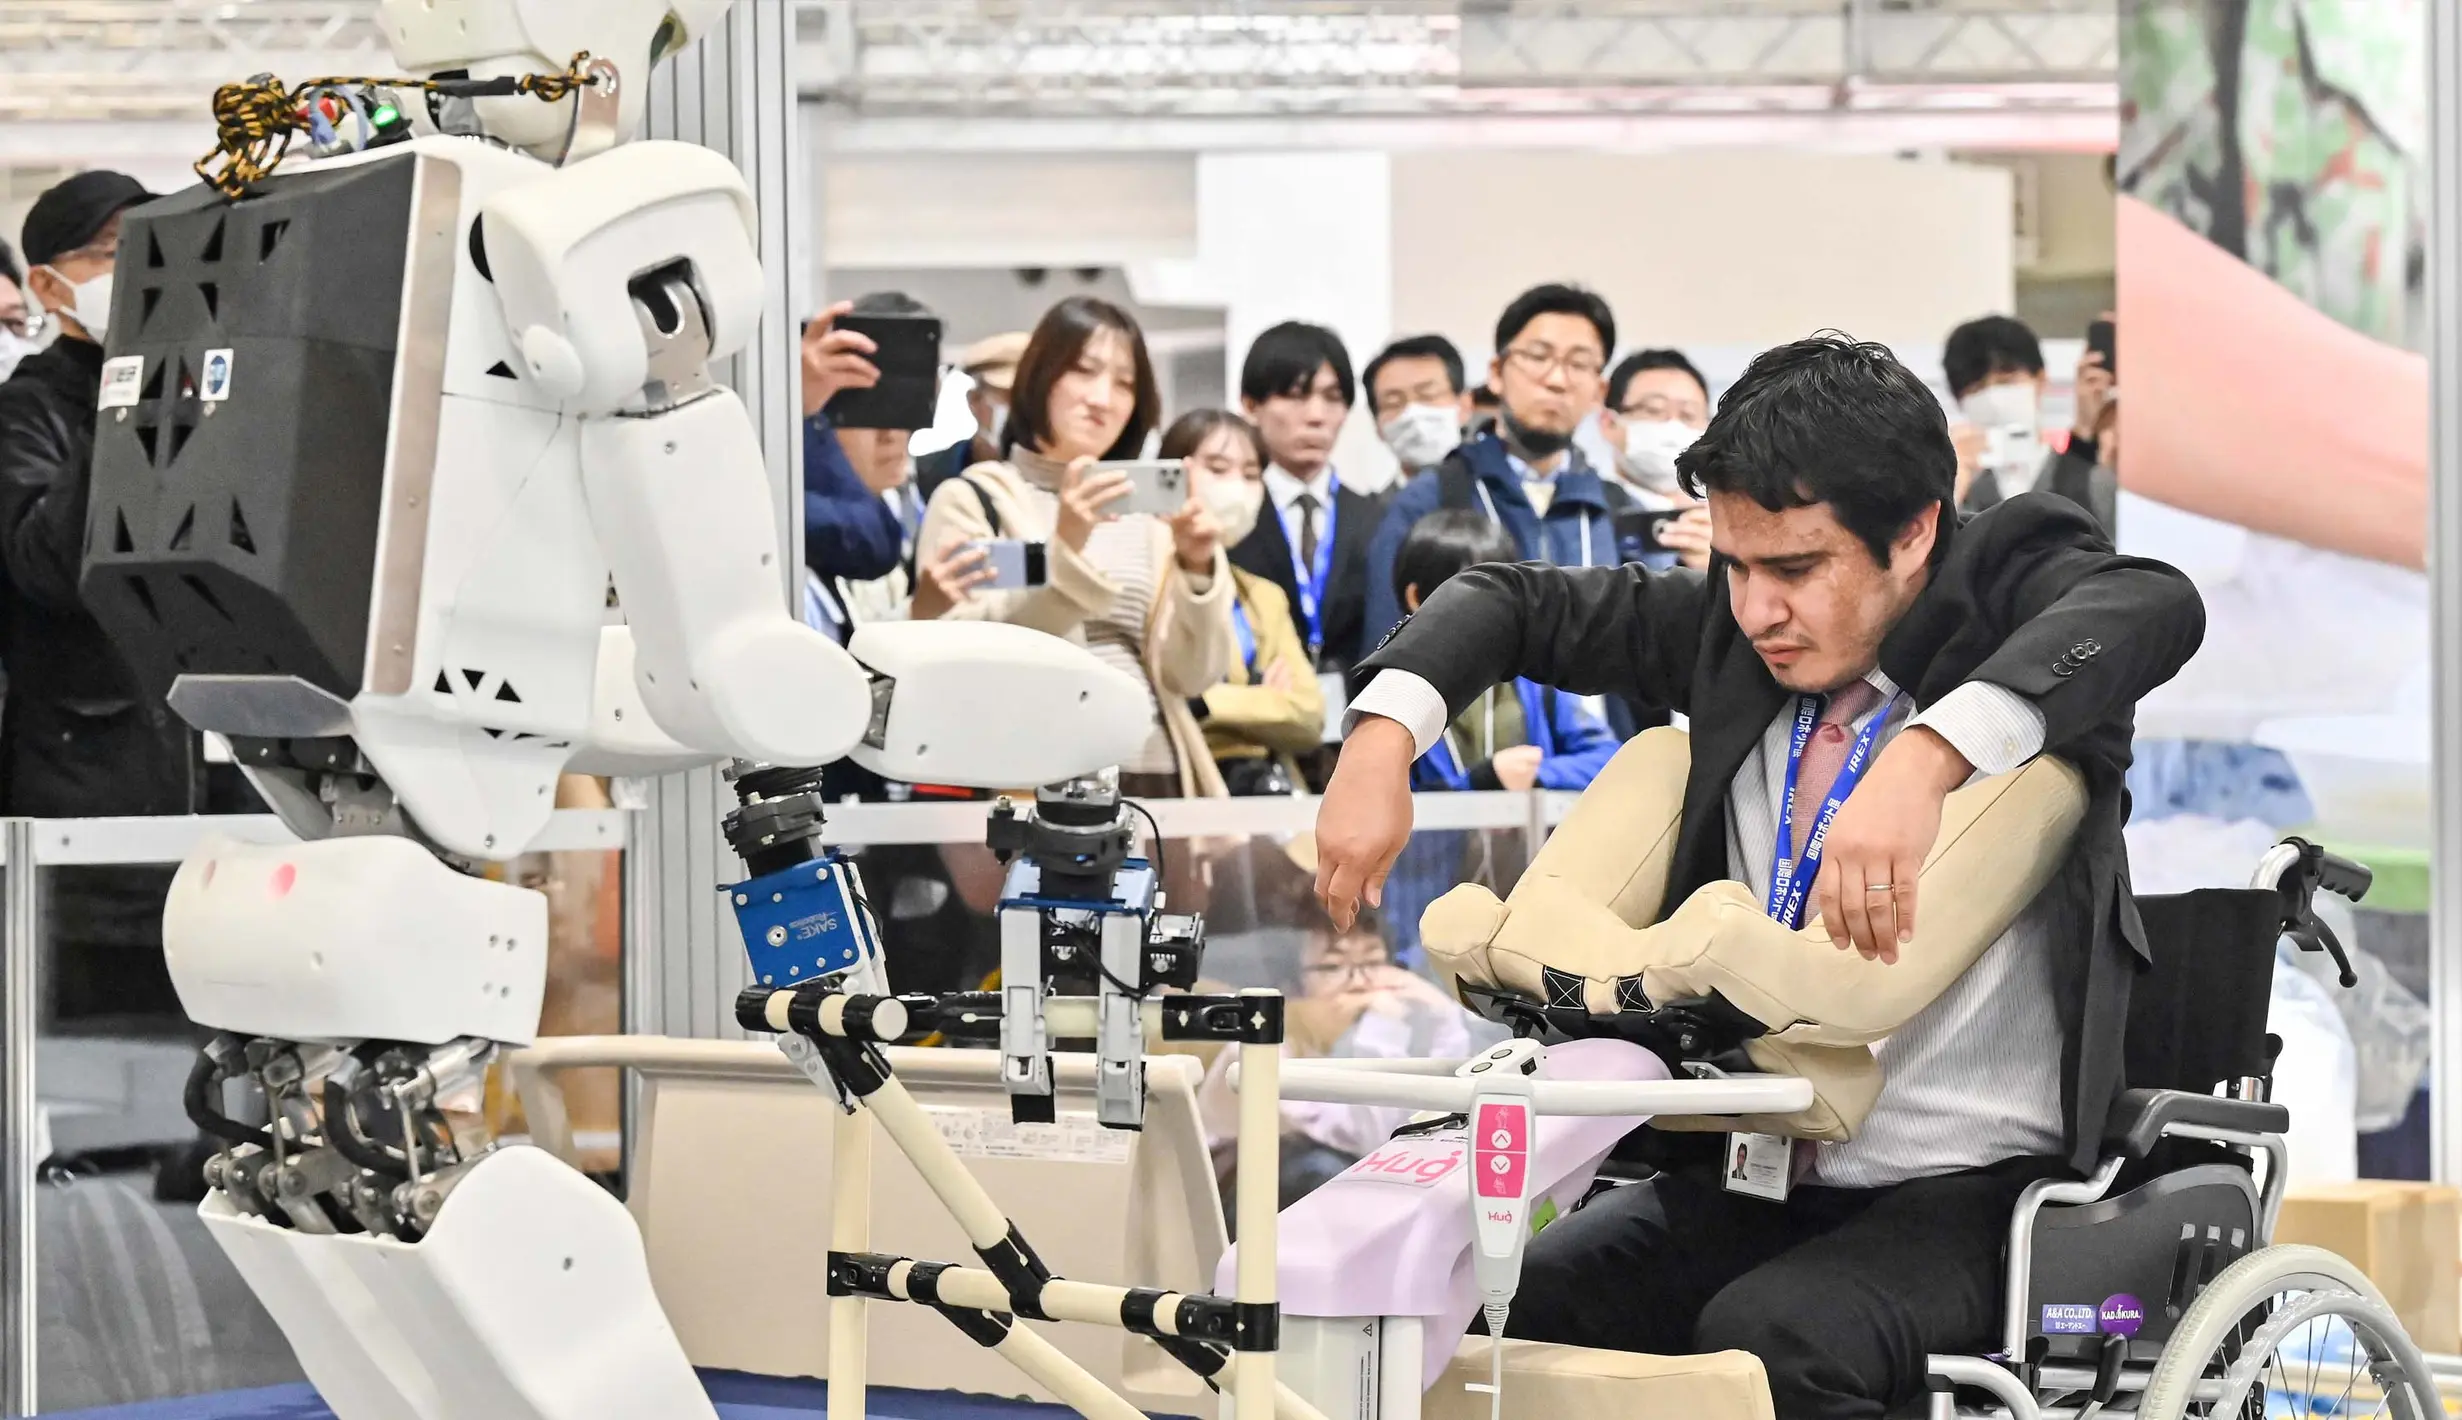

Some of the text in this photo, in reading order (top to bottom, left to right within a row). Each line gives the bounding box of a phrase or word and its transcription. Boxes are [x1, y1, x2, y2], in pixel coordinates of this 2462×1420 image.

[1806, 797, 1841, 861] 国際ロボット展
[1353, 1150, 1464, 1183] Hug
[1487, 1210, 1513, 1224] Hug
[2046, 1307, 2063, 1319] A&A
